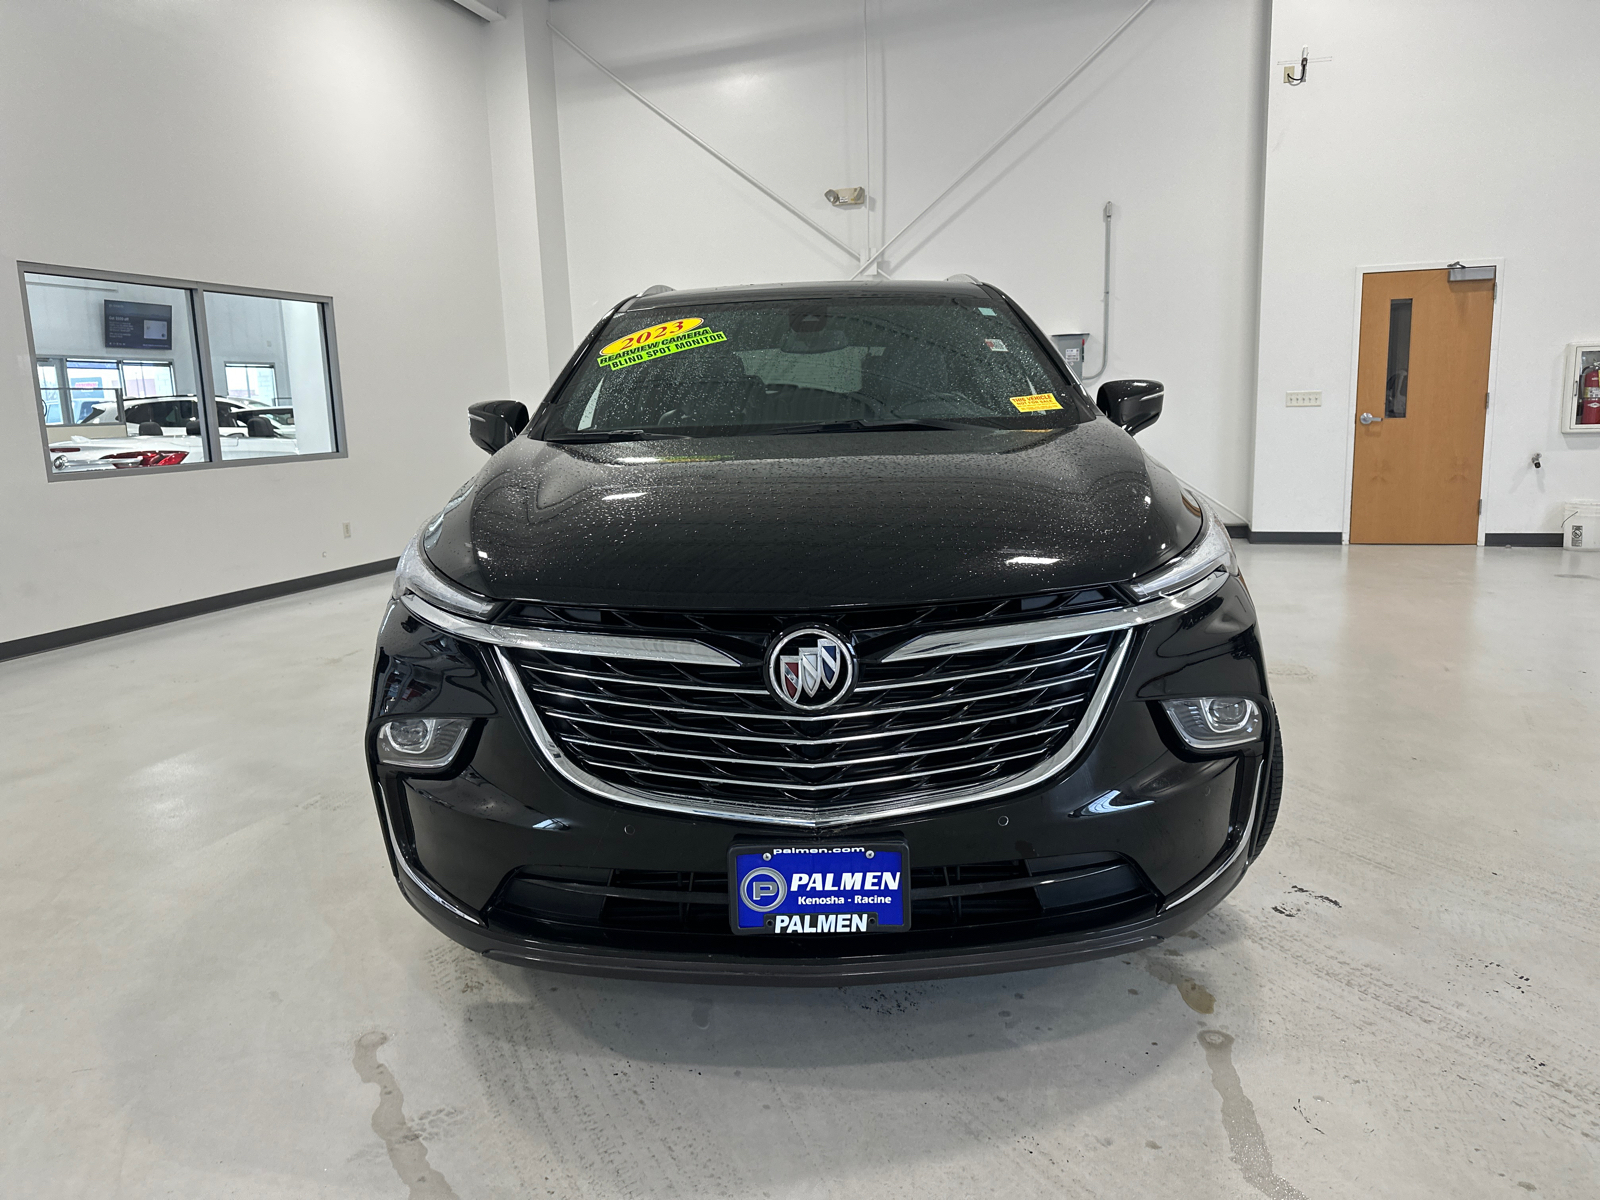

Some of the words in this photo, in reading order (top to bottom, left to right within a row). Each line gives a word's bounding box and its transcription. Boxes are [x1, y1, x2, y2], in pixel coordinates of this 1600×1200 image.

[621, 322, 684, 351] 2023
[600, 341, 660, 364] REARVIEW
[661, 329, 709, 346] CAMERA
[612, 356, 644, 369] BLIND
[646, 346, 672, 358] SPOT
[676, 333, 725, 350] MONITOR
[773, 847, 865, 855] palmen.com
[753, 881, 778, 900] P
[790, 872, 901, 891] PALMEN
[798, 896, 845, 905] Kenosha
[854, 895, 892, 904] Racine
[774, 914, 868, 933] PALMEN
